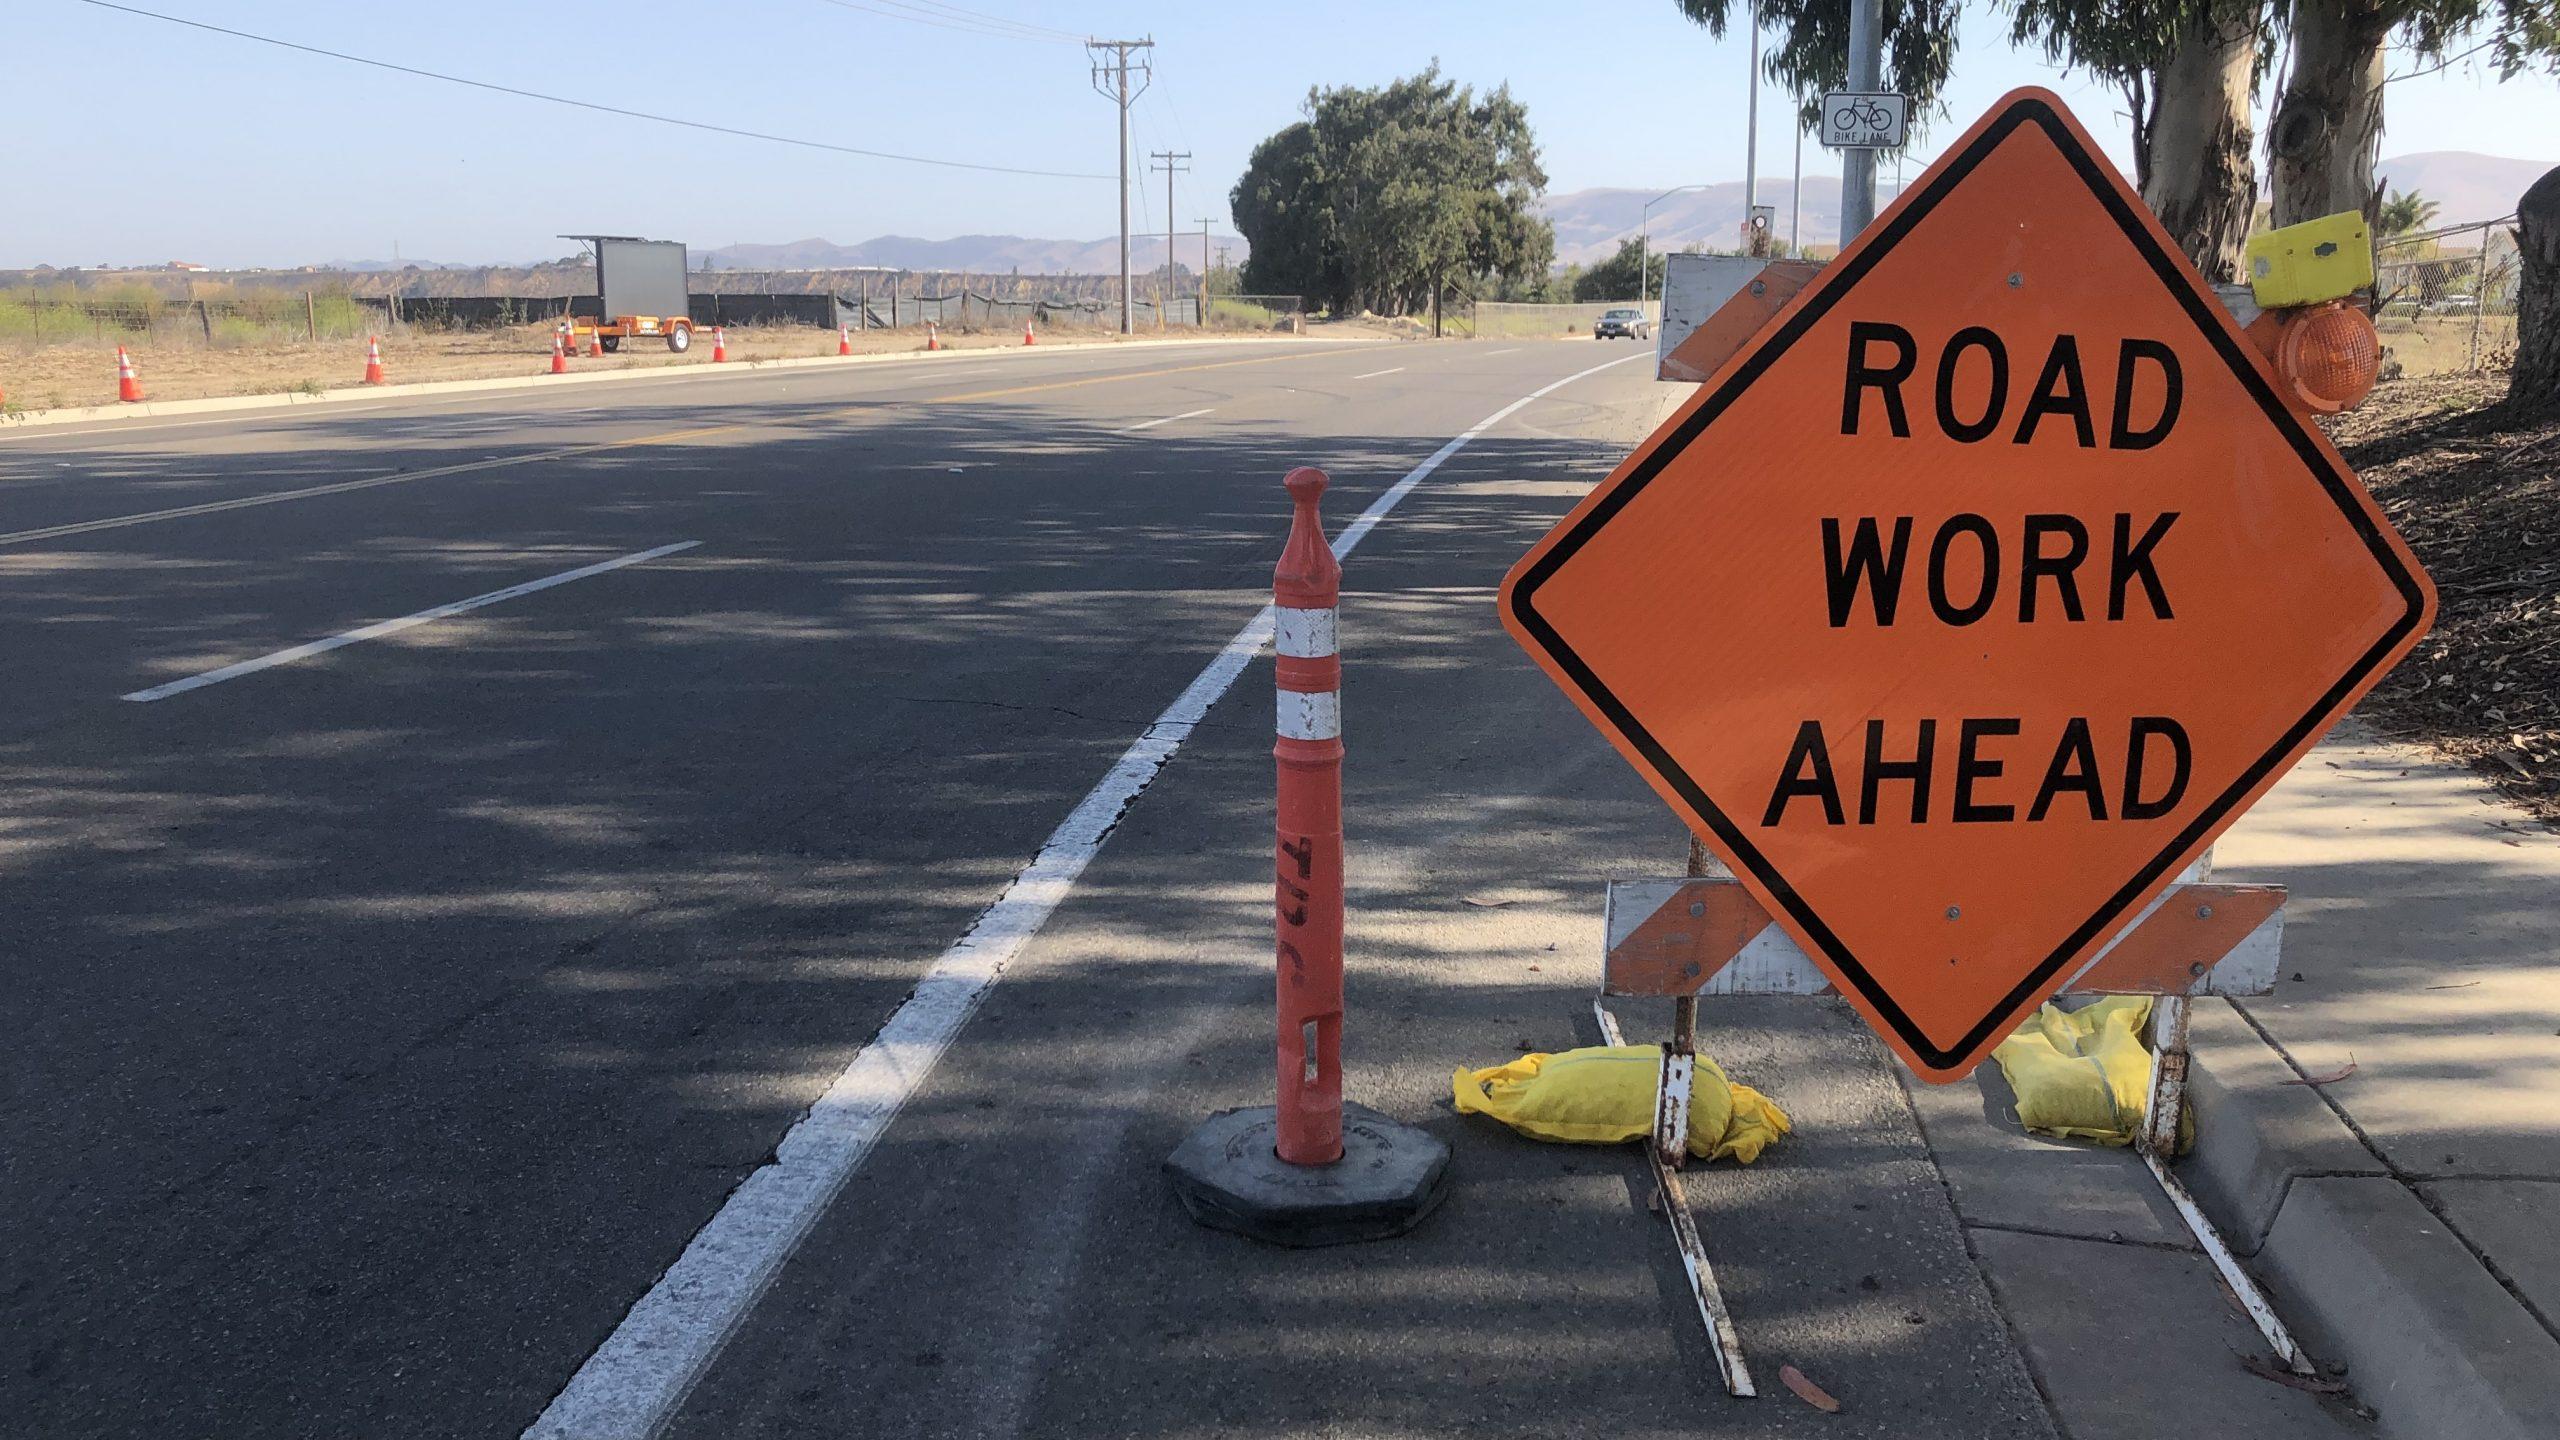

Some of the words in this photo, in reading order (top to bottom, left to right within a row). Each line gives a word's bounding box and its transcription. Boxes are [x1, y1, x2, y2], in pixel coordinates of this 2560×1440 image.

[1834, 131, 1857, 143] BIKE
[1863, 132, 1891, 144] LANE
[1841, 321, 2183, 450] ROAD
[1821, 512, 2181, 627] WORK
[1761, 717, 2192, 827] AHEAD
